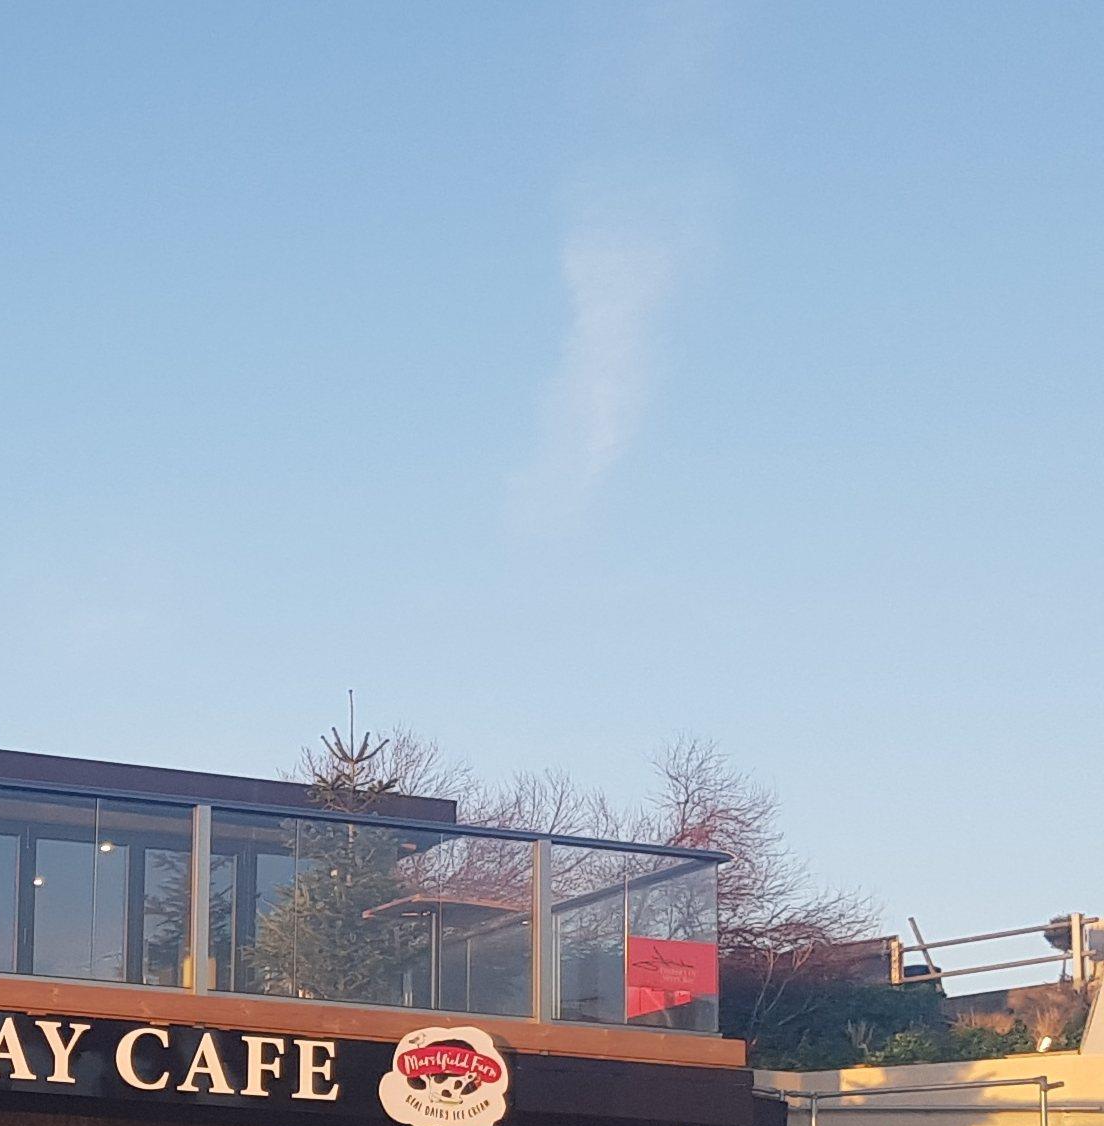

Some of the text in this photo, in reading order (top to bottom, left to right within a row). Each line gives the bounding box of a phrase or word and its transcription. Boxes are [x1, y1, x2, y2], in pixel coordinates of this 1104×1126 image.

[115, 1028, 340, 1101] CAFE
[405, 1094, 491, 1120] REAL DAIRY ICE CREAM
